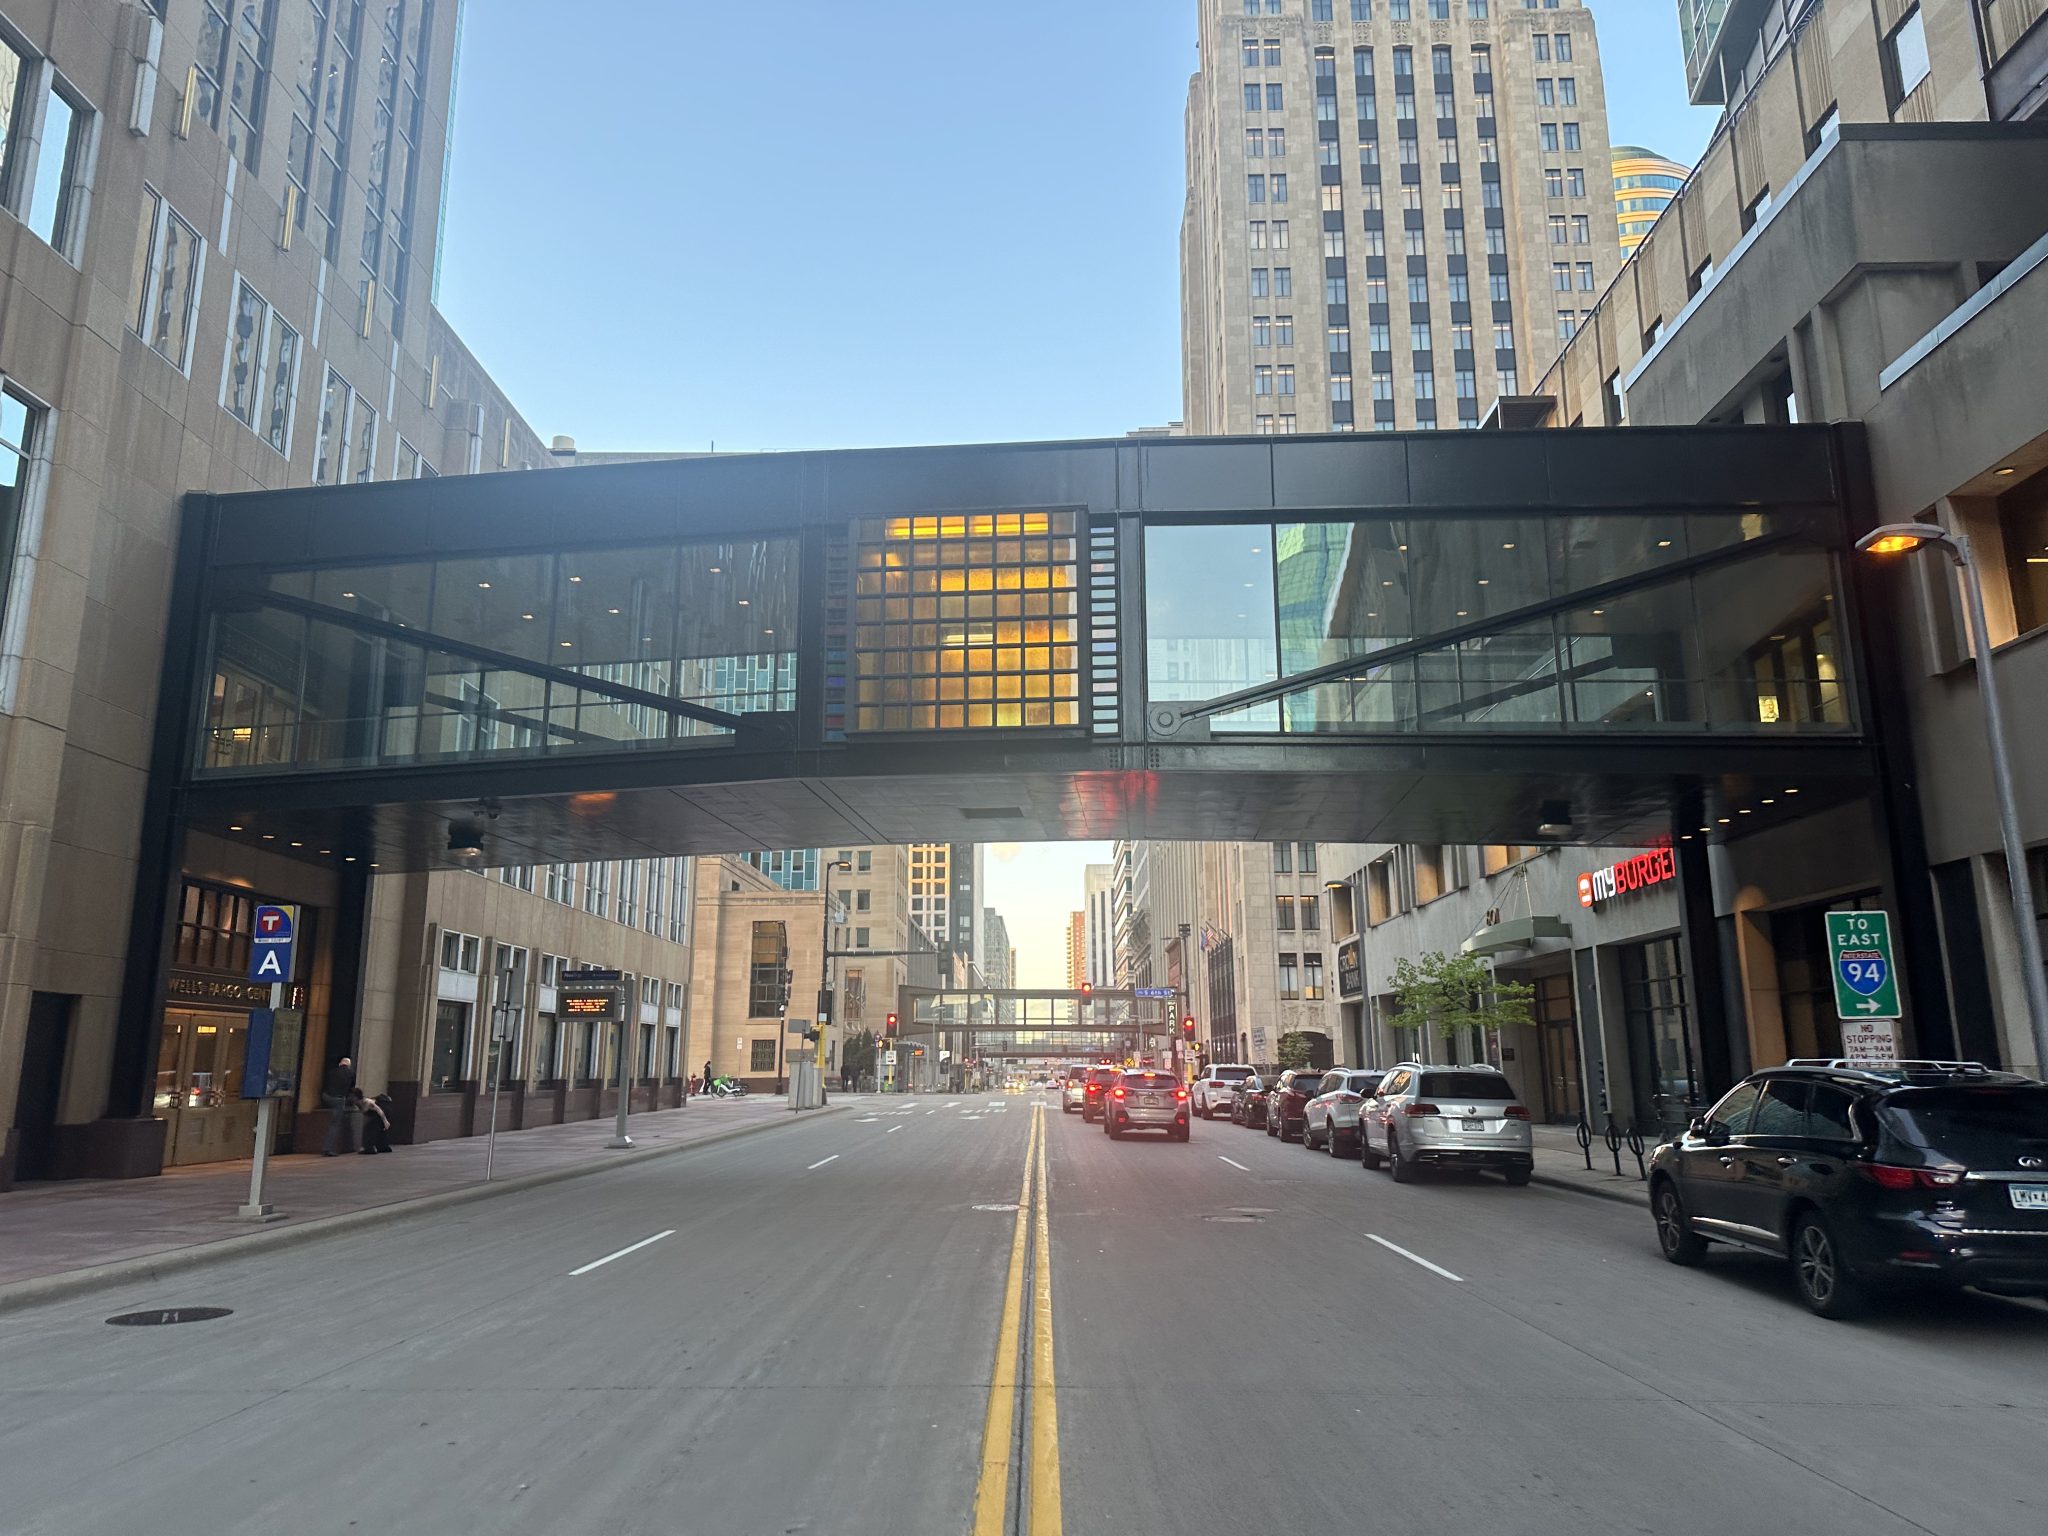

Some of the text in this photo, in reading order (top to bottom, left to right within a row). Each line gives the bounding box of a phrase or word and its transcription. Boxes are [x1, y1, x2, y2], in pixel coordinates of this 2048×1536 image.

[1846, 918, 1868, 930] TO
[1837, 933, 1880, 945] EAST
[257, 950, 282, 975] A
[1847, 962, 1880, 982] 94
[168, 979, 271, 1000] WELLS FARGO CENT
[1861, 1024, 1874, 1033] NO
[1846, 1034, 1892, 1043] STOPPING
